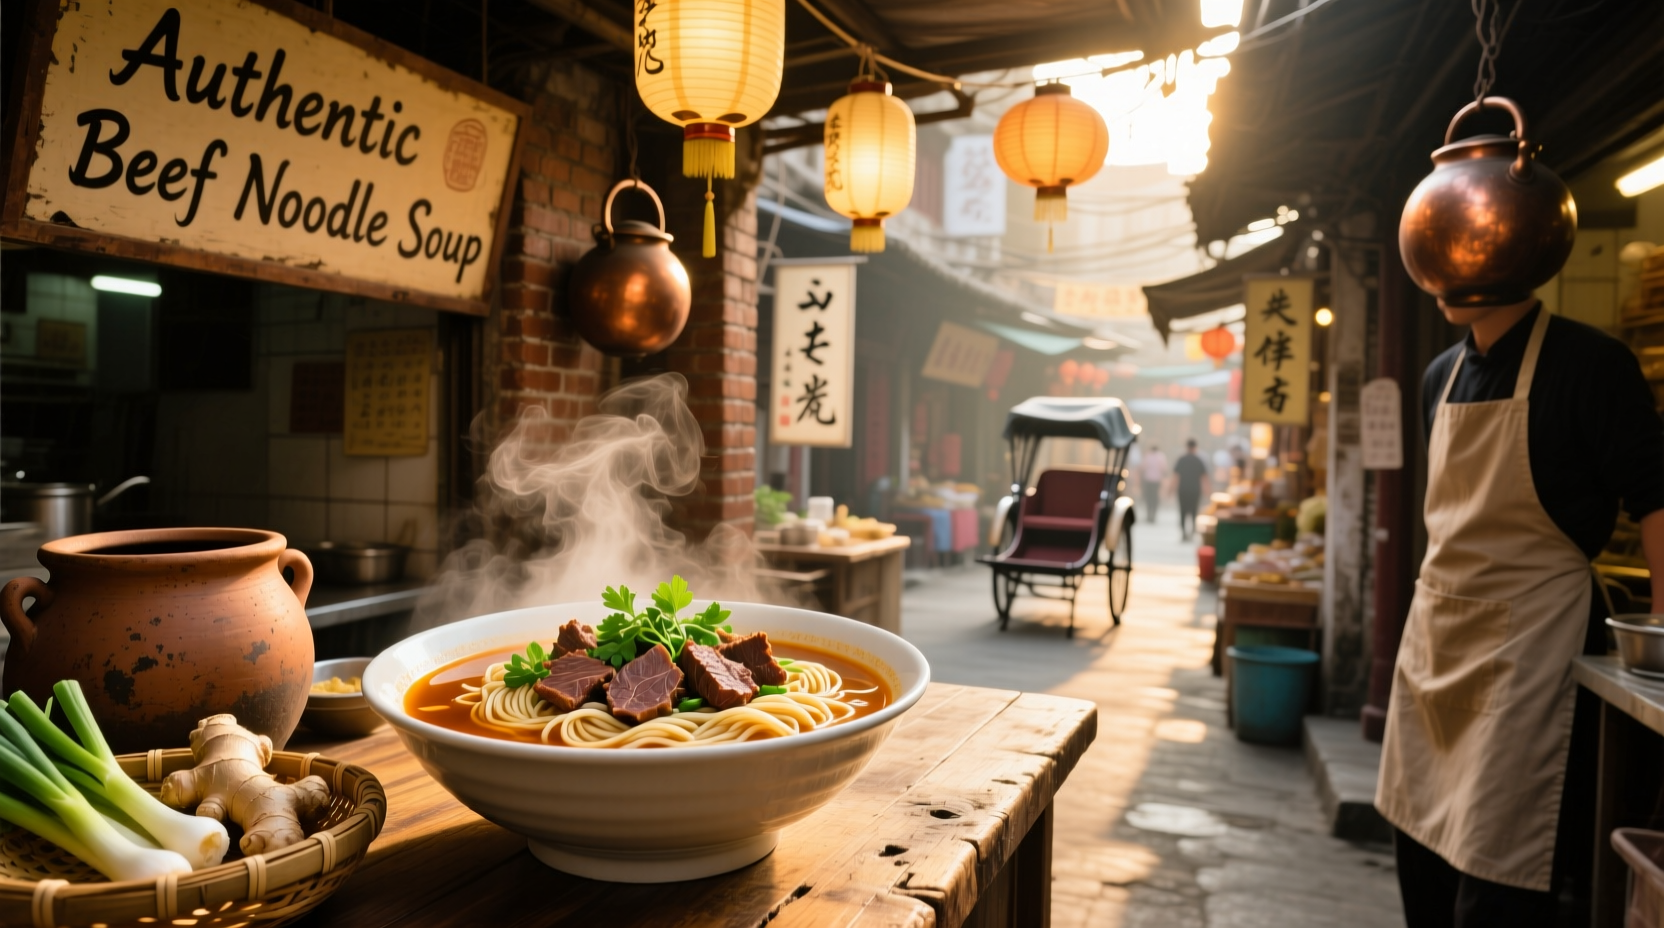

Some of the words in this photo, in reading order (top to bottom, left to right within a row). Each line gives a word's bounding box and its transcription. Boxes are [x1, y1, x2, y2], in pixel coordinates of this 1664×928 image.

[109, 8, 421, 166] Authentic
[68, 109, 228, 227] Beef
[233, 153, 389, 247] Noodle
[397, 199, 482, 284] Soup
